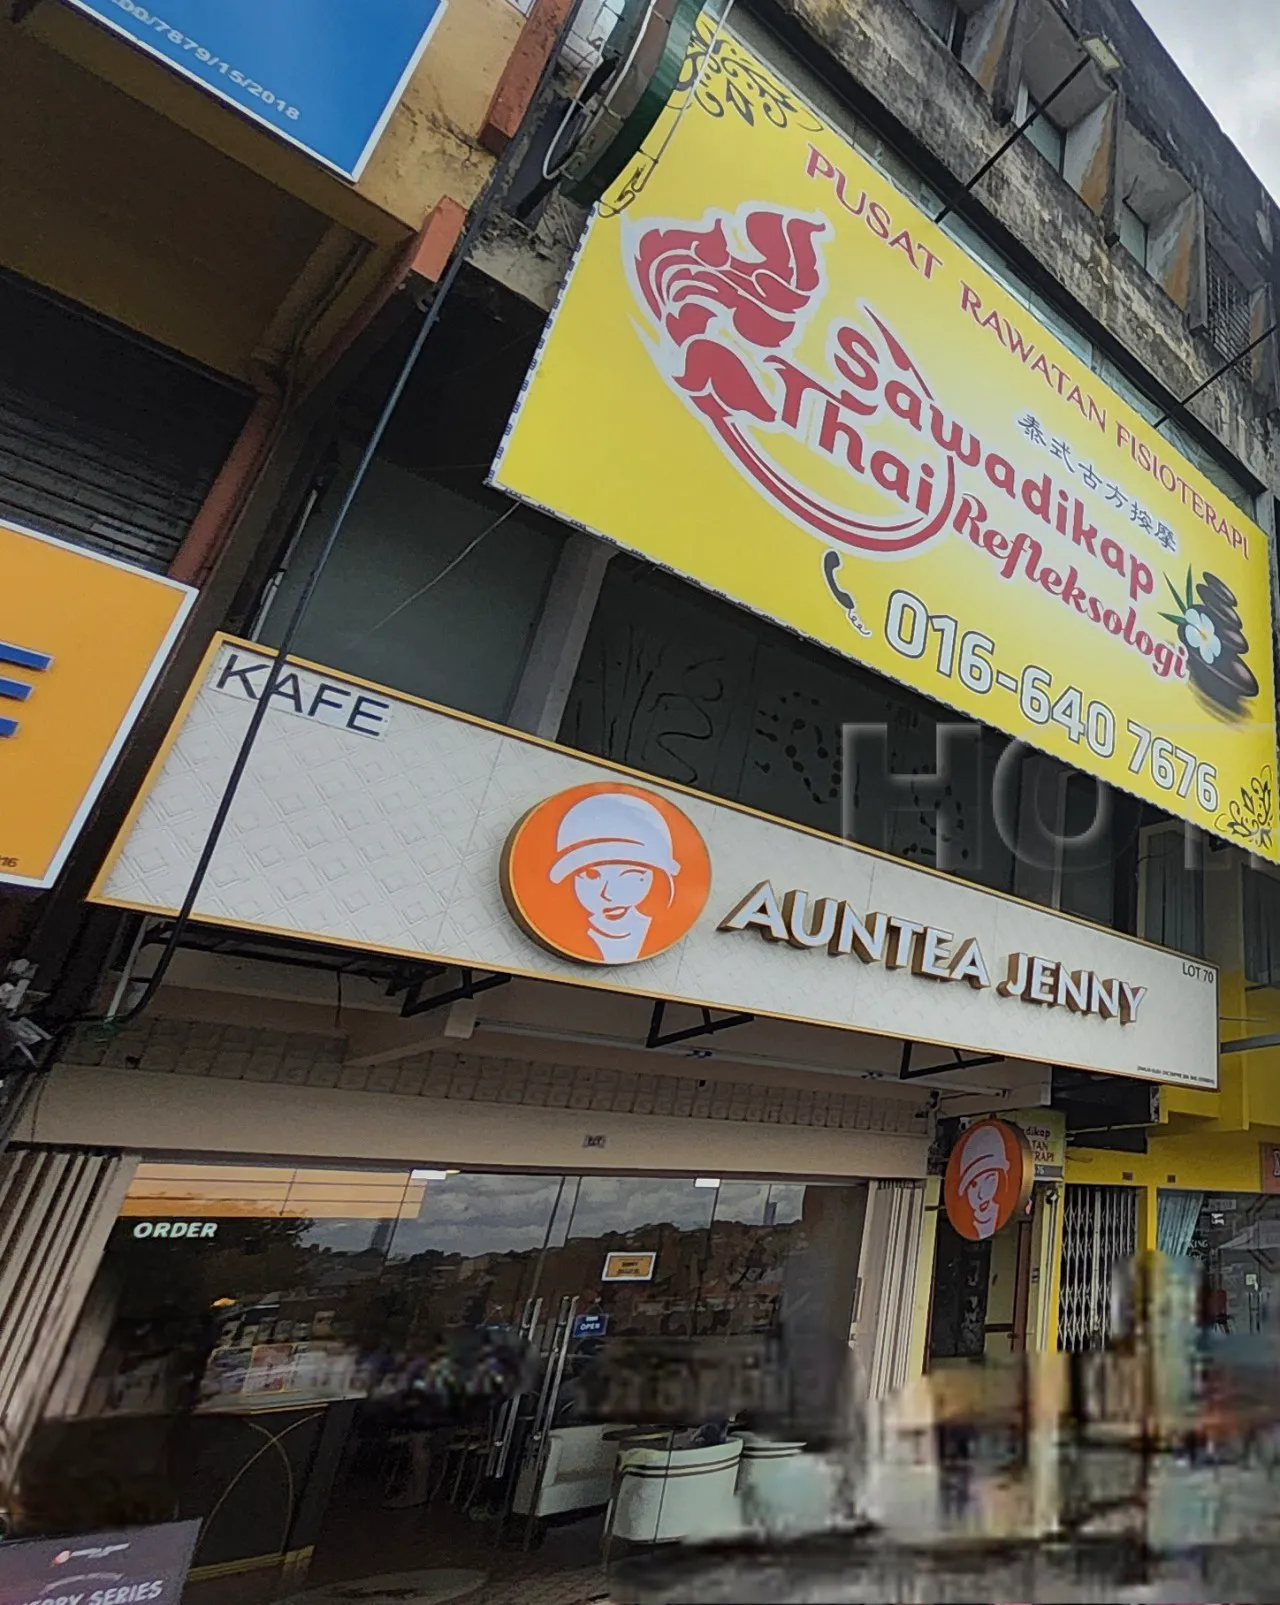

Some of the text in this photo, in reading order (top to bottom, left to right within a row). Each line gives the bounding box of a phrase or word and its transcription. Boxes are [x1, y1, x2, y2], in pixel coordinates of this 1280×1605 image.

[805, 143, 1252, 560] PUSAT RAWATAN FISIOTERAPI
[770, 354, 935, 514] Thai
[831, 304, 1155, 600] Sawadikap
[1016, 411, 1179, 555] 泰式古方按摩
[952, 494, 1190, 681] Refleksologi
[216, 652, 391, 737] KAFE
[885, 588, 1221, 813] 016-640 7676
[718, 879, 1148, 1025] AUNTEA JENNY
[1182, 962, 1215, 984] LOT 70
[133, 1222, 218, 1239] ORDER
[88, 1579, 163, 1605] SERIES
